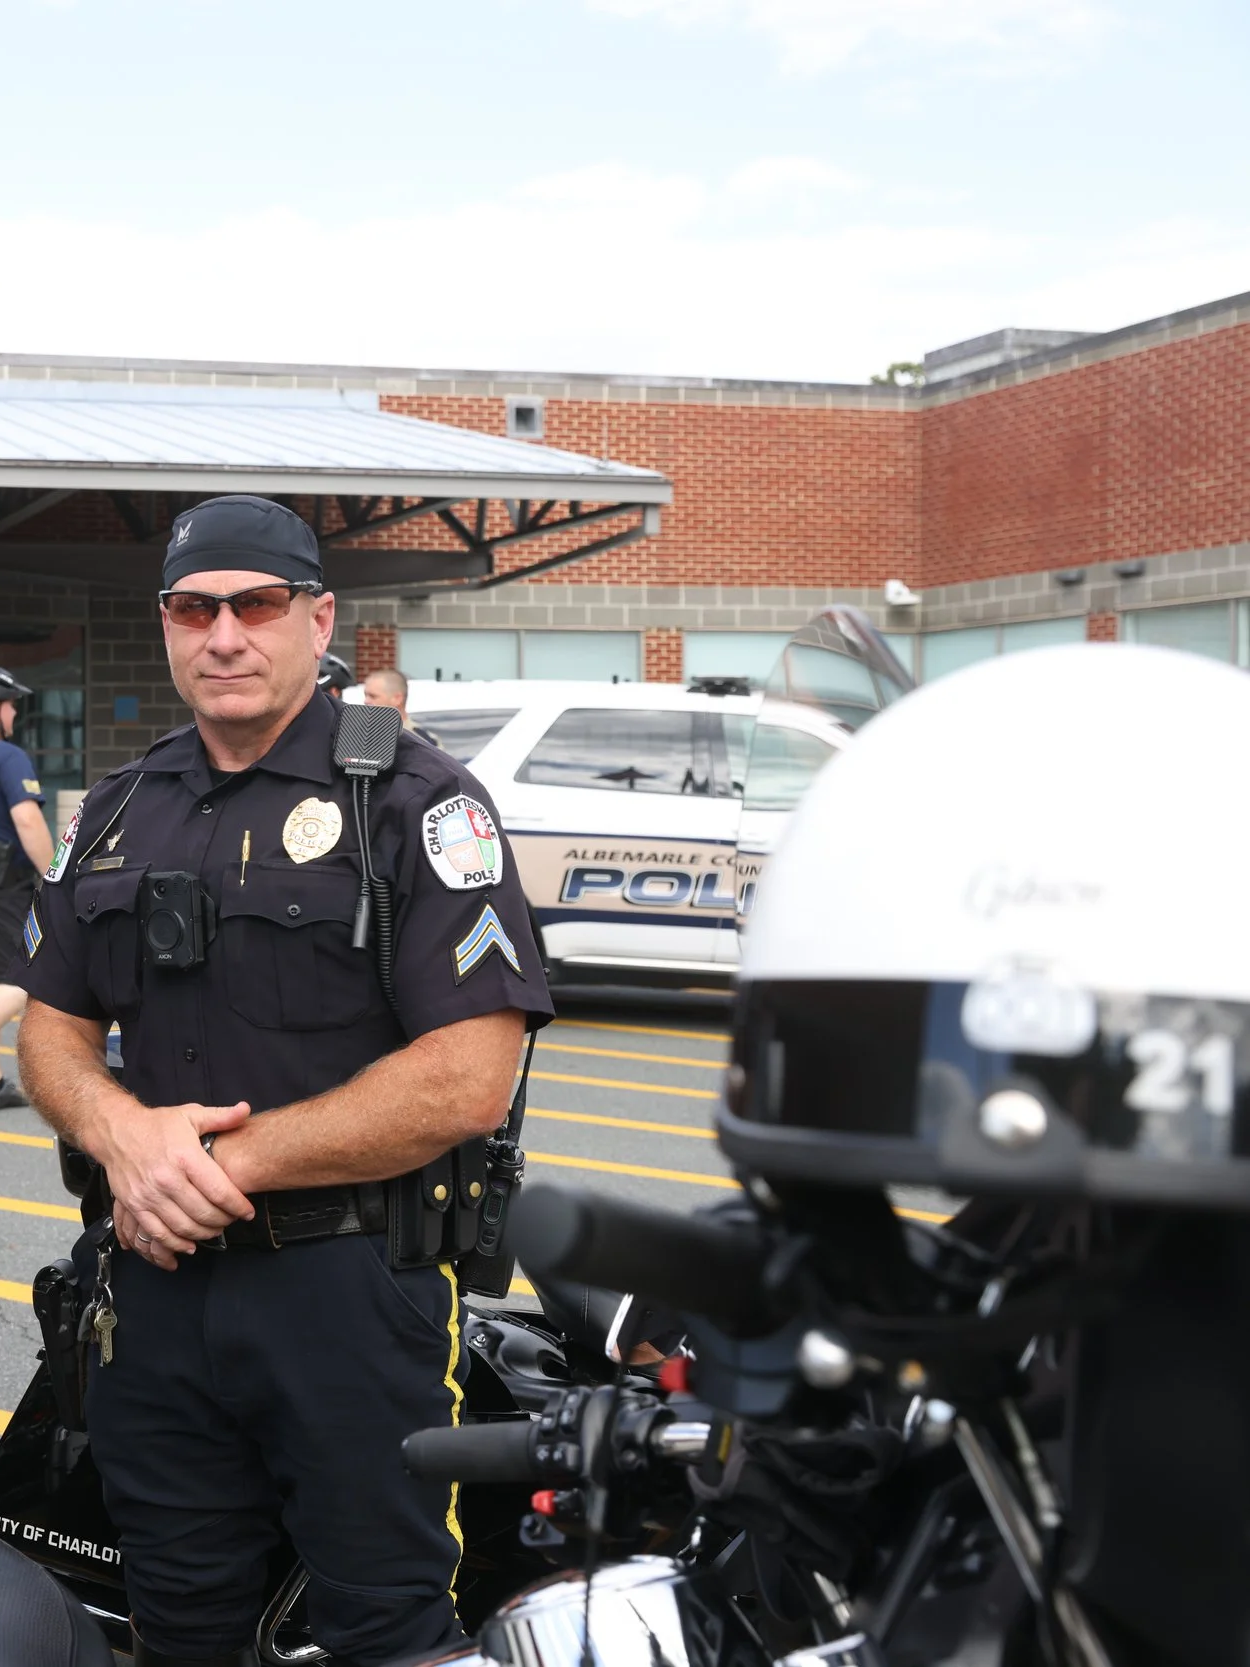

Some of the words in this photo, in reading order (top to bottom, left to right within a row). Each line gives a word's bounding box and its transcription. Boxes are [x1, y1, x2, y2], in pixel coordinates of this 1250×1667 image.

[563, 848, 703, 866] ALBEMARLE
[1124, 1030, 1236, 1117] 21
[22, 1524, 46, 1542] OF
